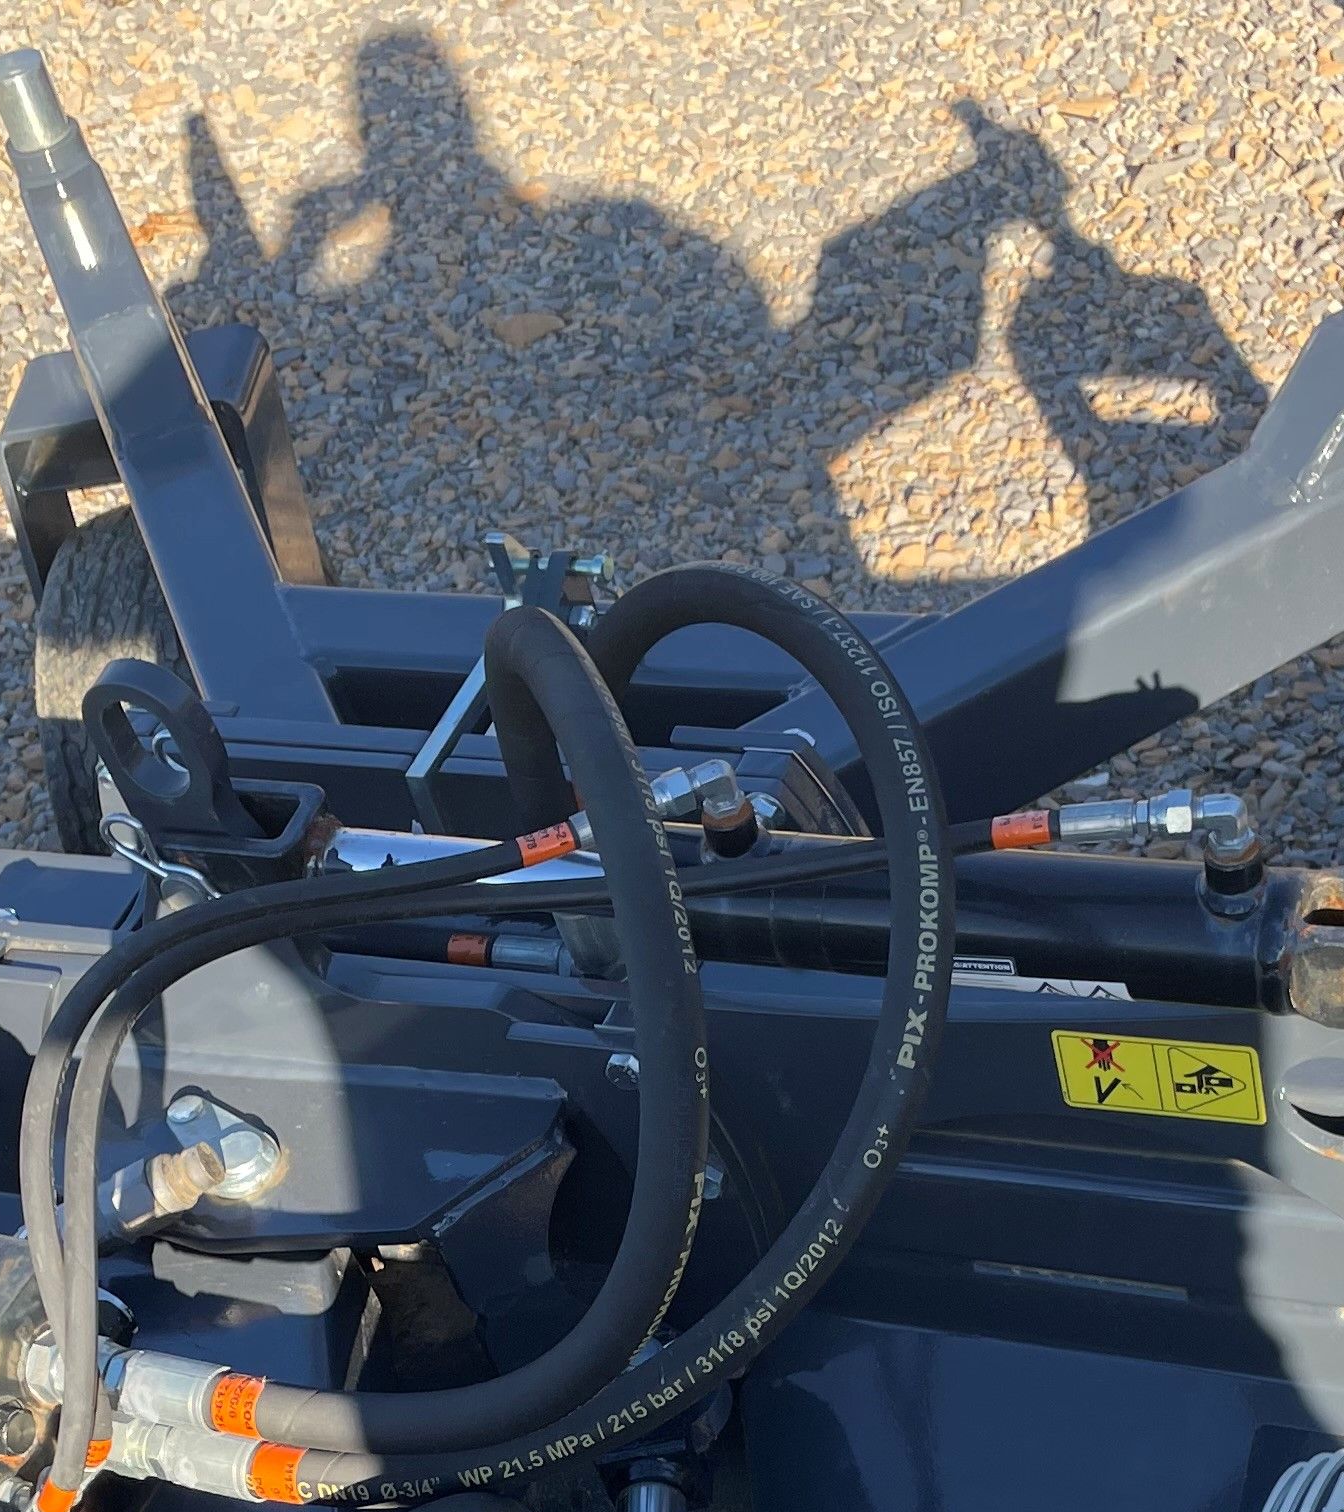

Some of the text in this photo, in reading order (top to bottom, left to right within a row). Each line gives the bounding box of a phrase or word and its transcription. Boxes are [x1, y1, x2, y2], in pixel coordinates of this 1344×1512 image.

[871, 681, 901, 719] ISO
[893, 737, 930, 812] EN857
[896, 1007, 928, 1070] PIX
[317, 1481, 371, 1502] DN19
[457, 1465, 494, 1489] WP
[498, 1450, 545, 1480] 21.5
[545, 1431, 596, 1462] MPa
[607, 1400, 648, 1434] 215
[646, 1377, 684, 1410] bar
[695, 1330, 745, 1374] 3118
[744, 1298, 778, 1340] psi
[773, 1217, 844, 1300] 1Q/2012
